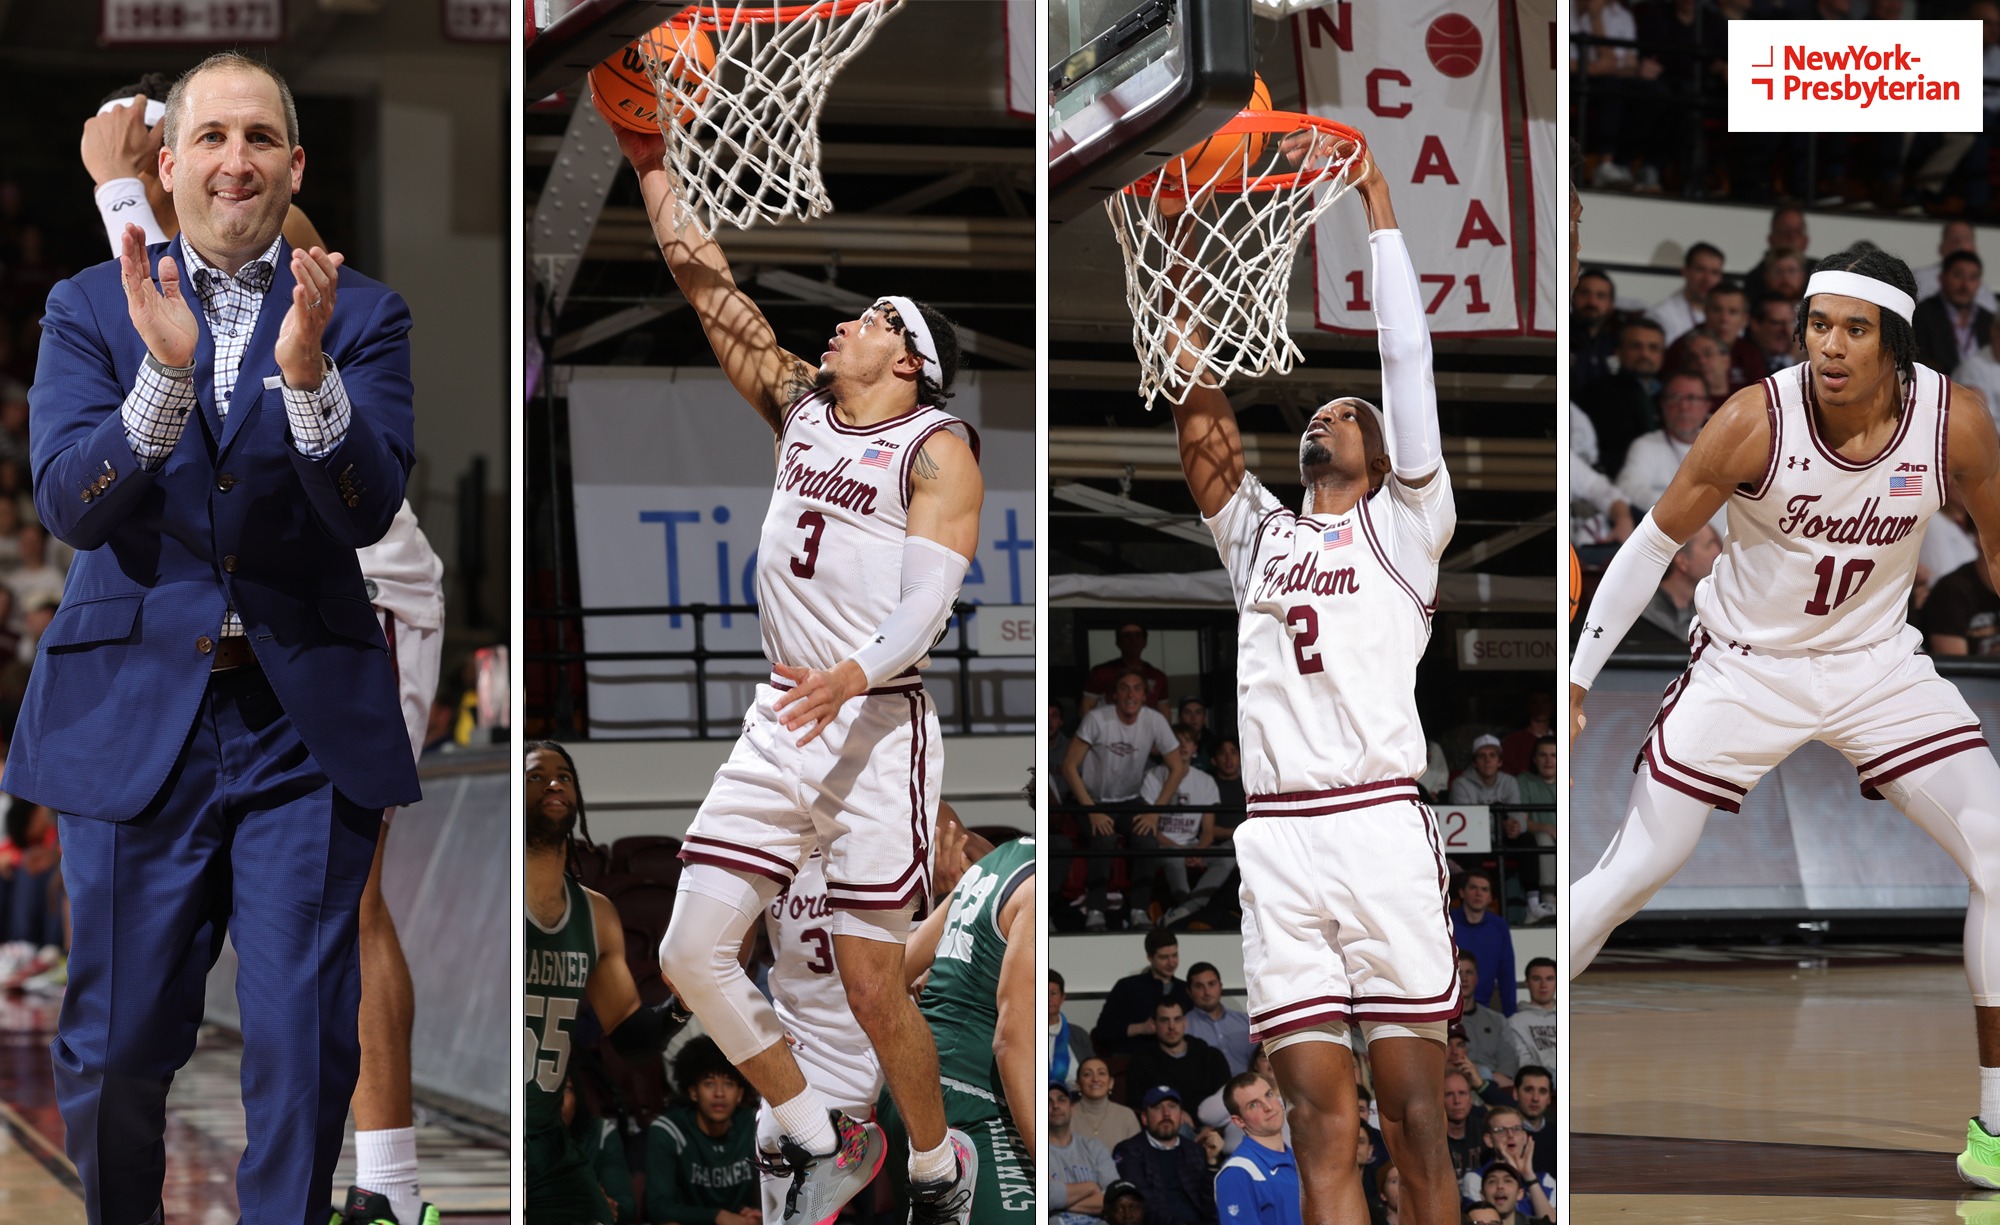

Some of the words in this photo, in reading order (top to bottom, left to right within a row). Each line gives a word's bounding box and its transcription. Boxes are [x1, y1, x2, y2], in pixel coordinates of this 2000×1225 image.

[1345, 270, 1490, 314] 171
[871, 438, 900, 449] A10
[777, 441, 878, 516] Fordham
[1894, 462, 1928, 472] A10
[1778, 494, 1918, 547] Fordham
[789, 510, 826, 580] 3
[1804, 555, 1876, 616] 10
[1001, 619, 1035, 642] SE
[1286, 604, 1325, 675] 2
[526, 949, 590, 988] AGNER
[801, 928, 835, 974] 3
